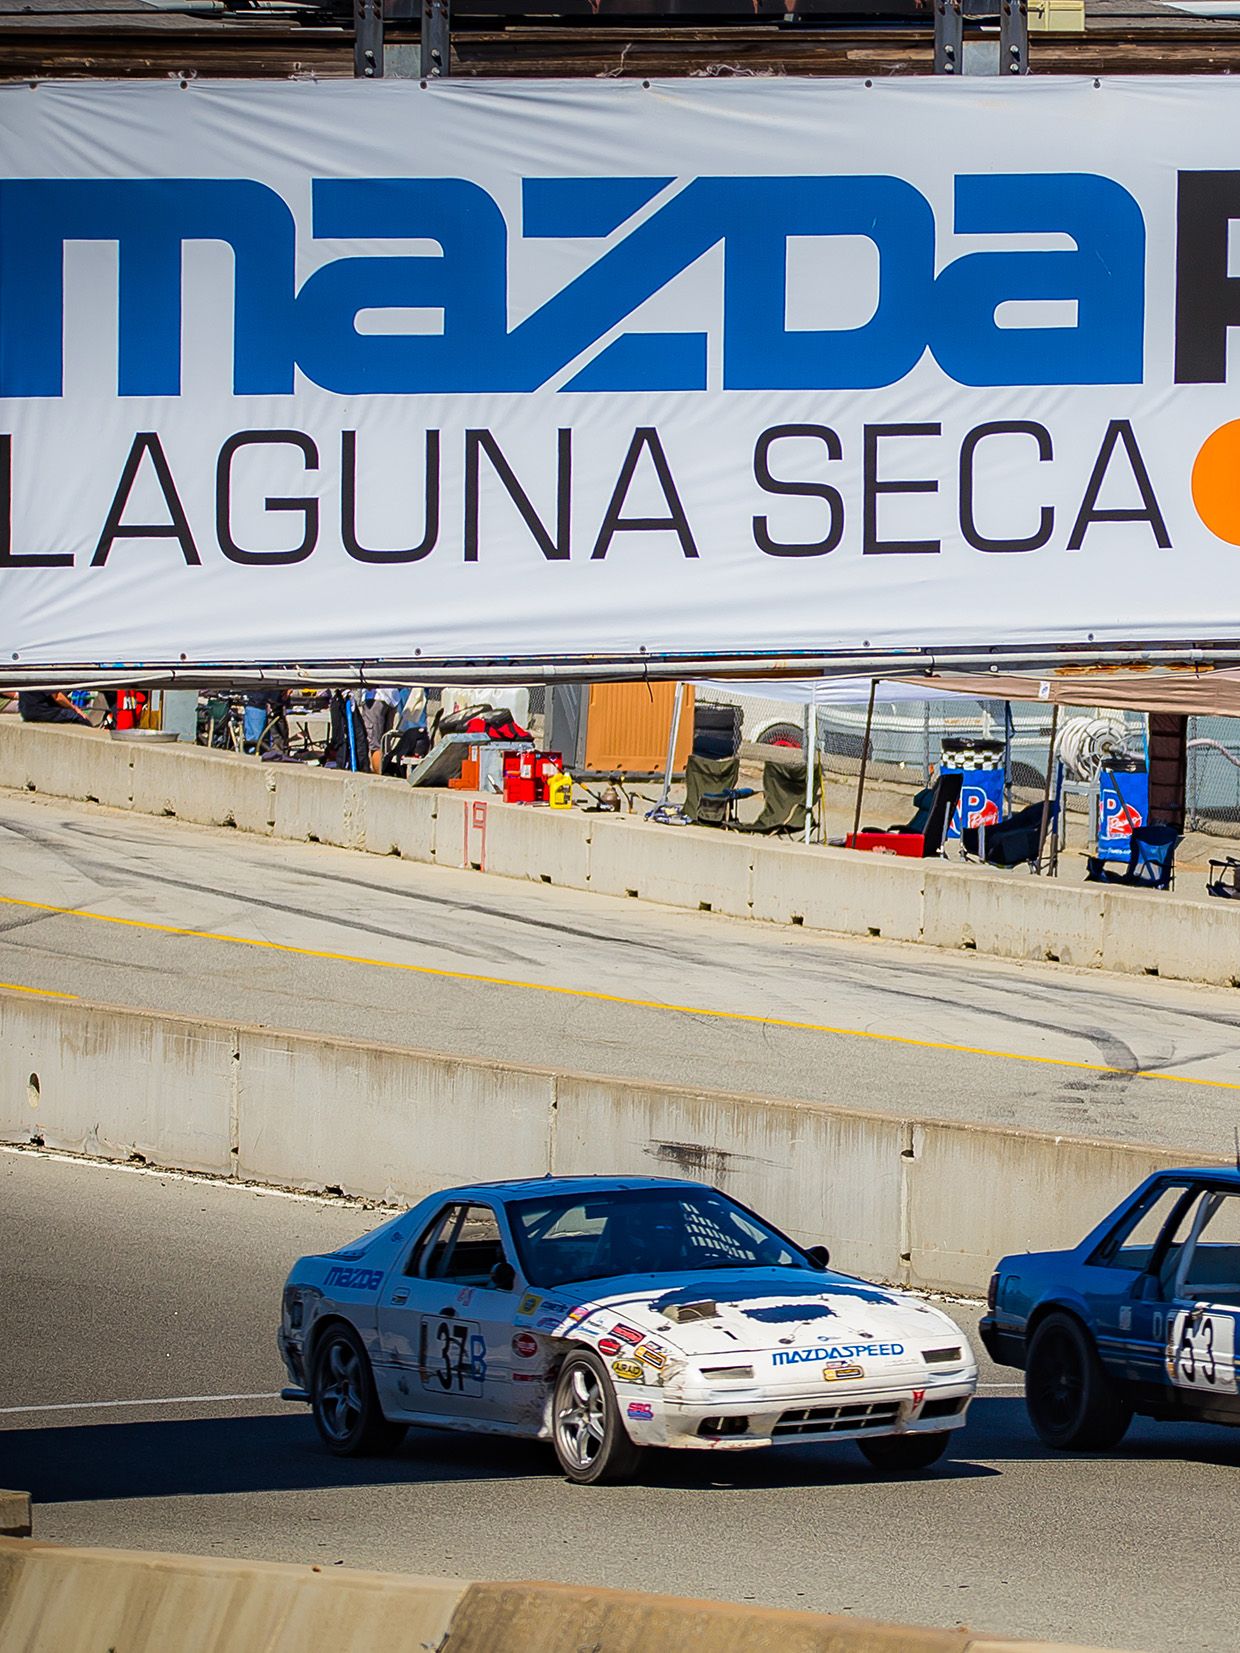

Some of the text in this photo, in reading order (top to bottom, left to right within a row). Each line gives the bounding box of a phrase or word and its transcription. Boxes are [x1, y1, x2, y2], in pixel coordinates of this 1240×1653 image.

[0, 419, 1173, 568] LAGUNA SECA
[772, 1343, 905, 1366] MAZDASPEED
[1180, 1315, 1216, 1385] 53
